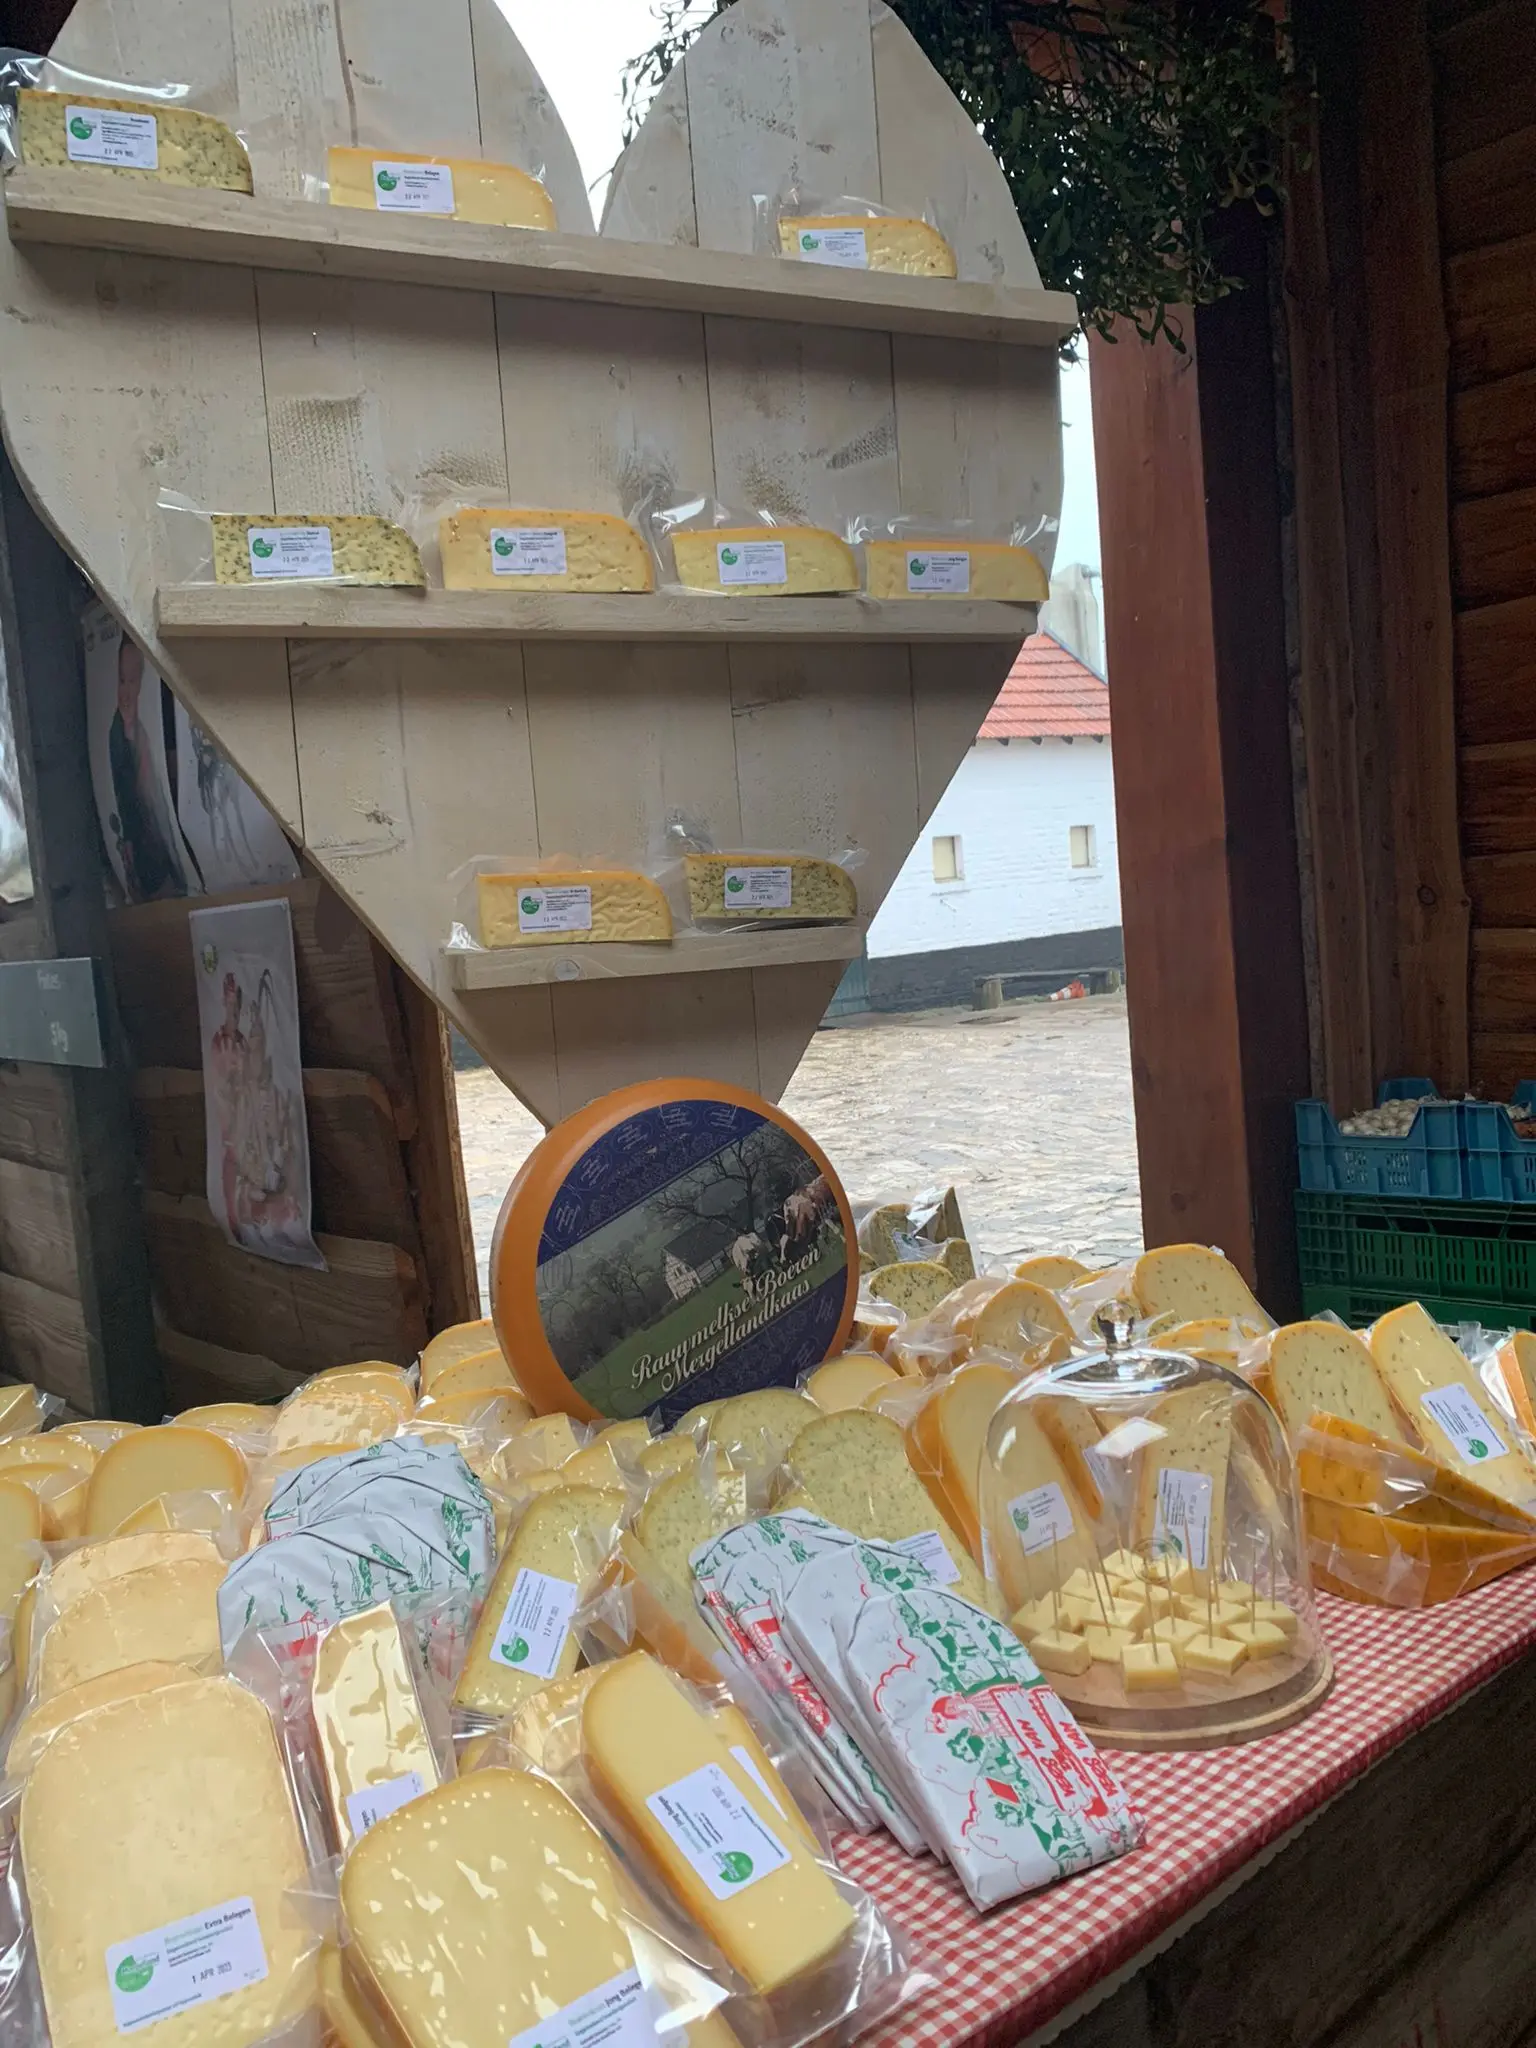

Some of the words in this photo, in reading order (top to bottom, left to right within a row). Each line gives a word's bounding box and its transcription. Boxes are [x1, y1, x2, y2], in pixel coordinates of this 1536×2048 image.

[631, 1297, 751, 1389] Rauwmelkse
[755, 1247, 820, 1301] Boeren
[661, 1279, 810, 1392] Mergellandkaas
[1017, 1719, 1045, 1749] VAN
[1060, 1721, 1088, 1750] VAN
[204, 1917, 223, 1930] Extra
[223, 1907, 251, 1922] Belegen
[200, 1967, 214, 1981] APR
[619, 1980, 642, 1998] Belege
